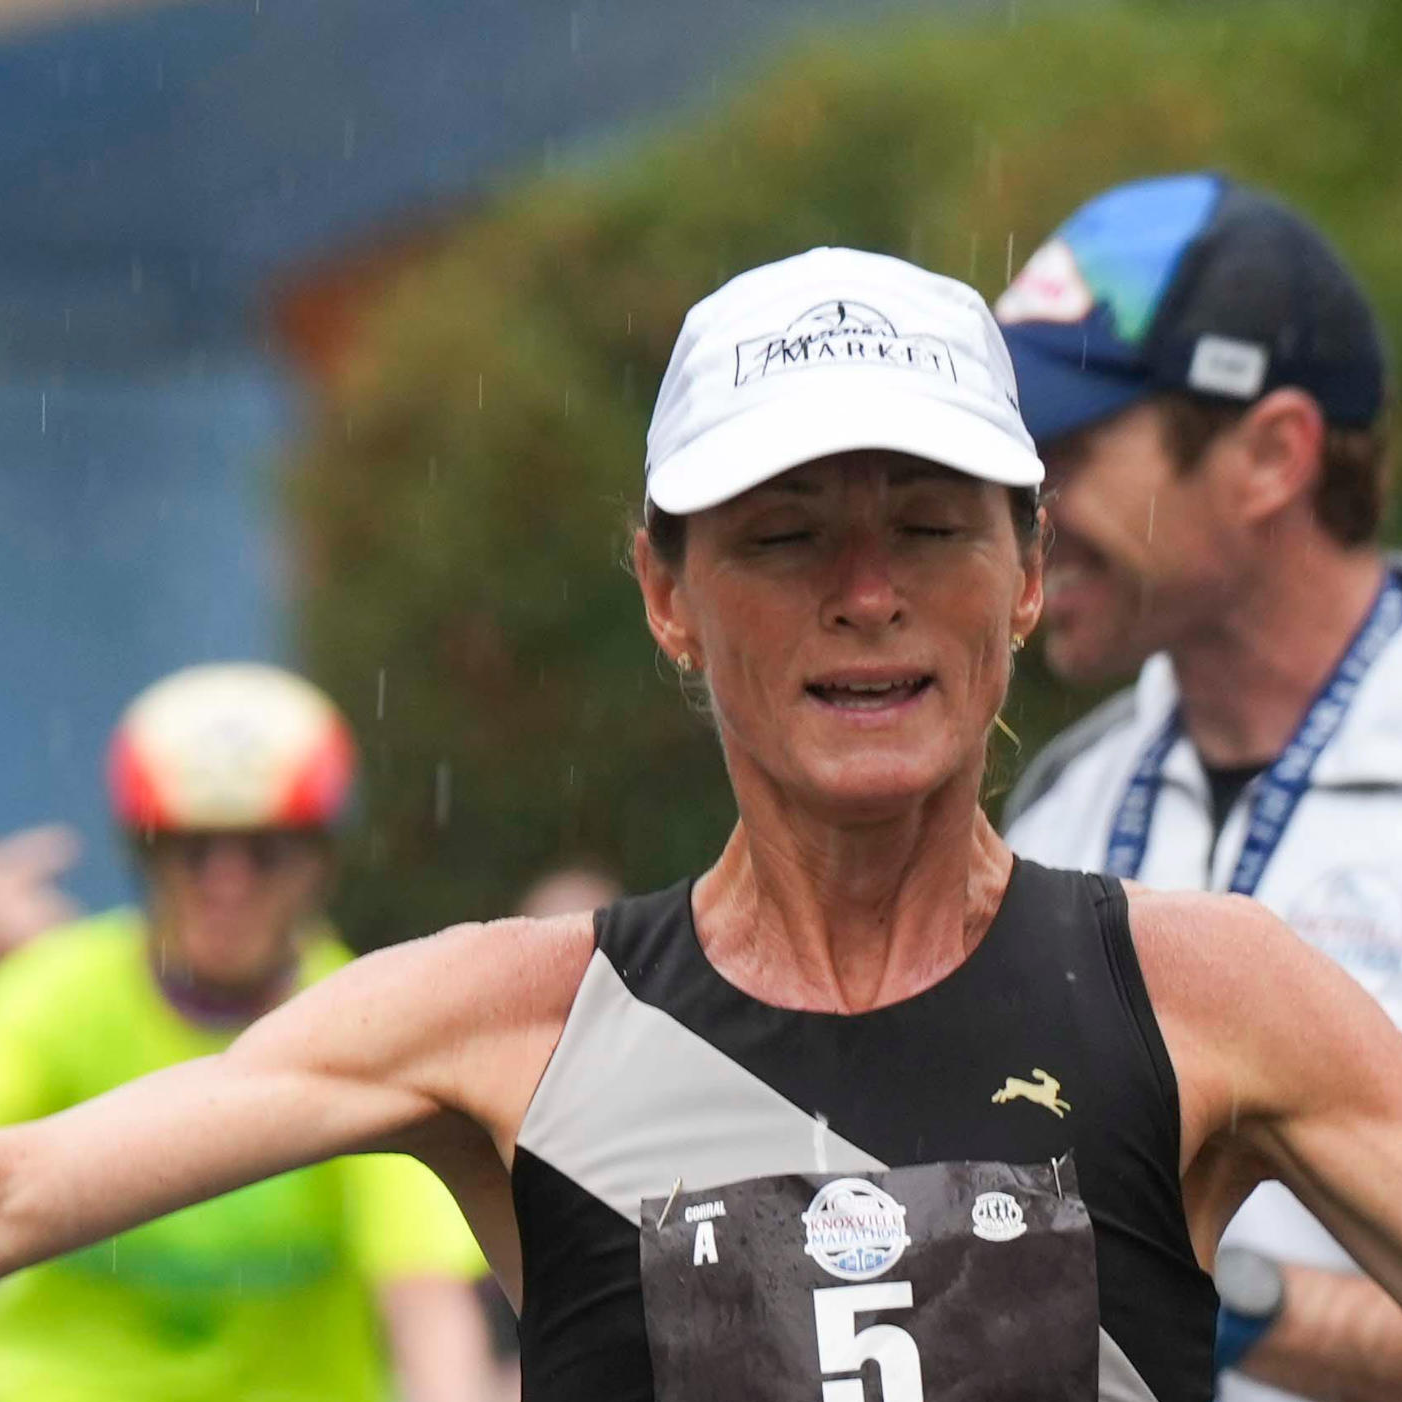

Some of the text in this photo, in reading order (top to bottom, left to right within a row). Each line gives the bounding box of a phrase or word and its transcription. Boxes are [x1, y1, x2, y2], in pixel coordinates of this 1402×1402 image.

[810, 1214, 903, 1233] KNOXVILLE
[693, 1220, 719, 1267] A
[811, 1227, 902, 1246] MARATHON
